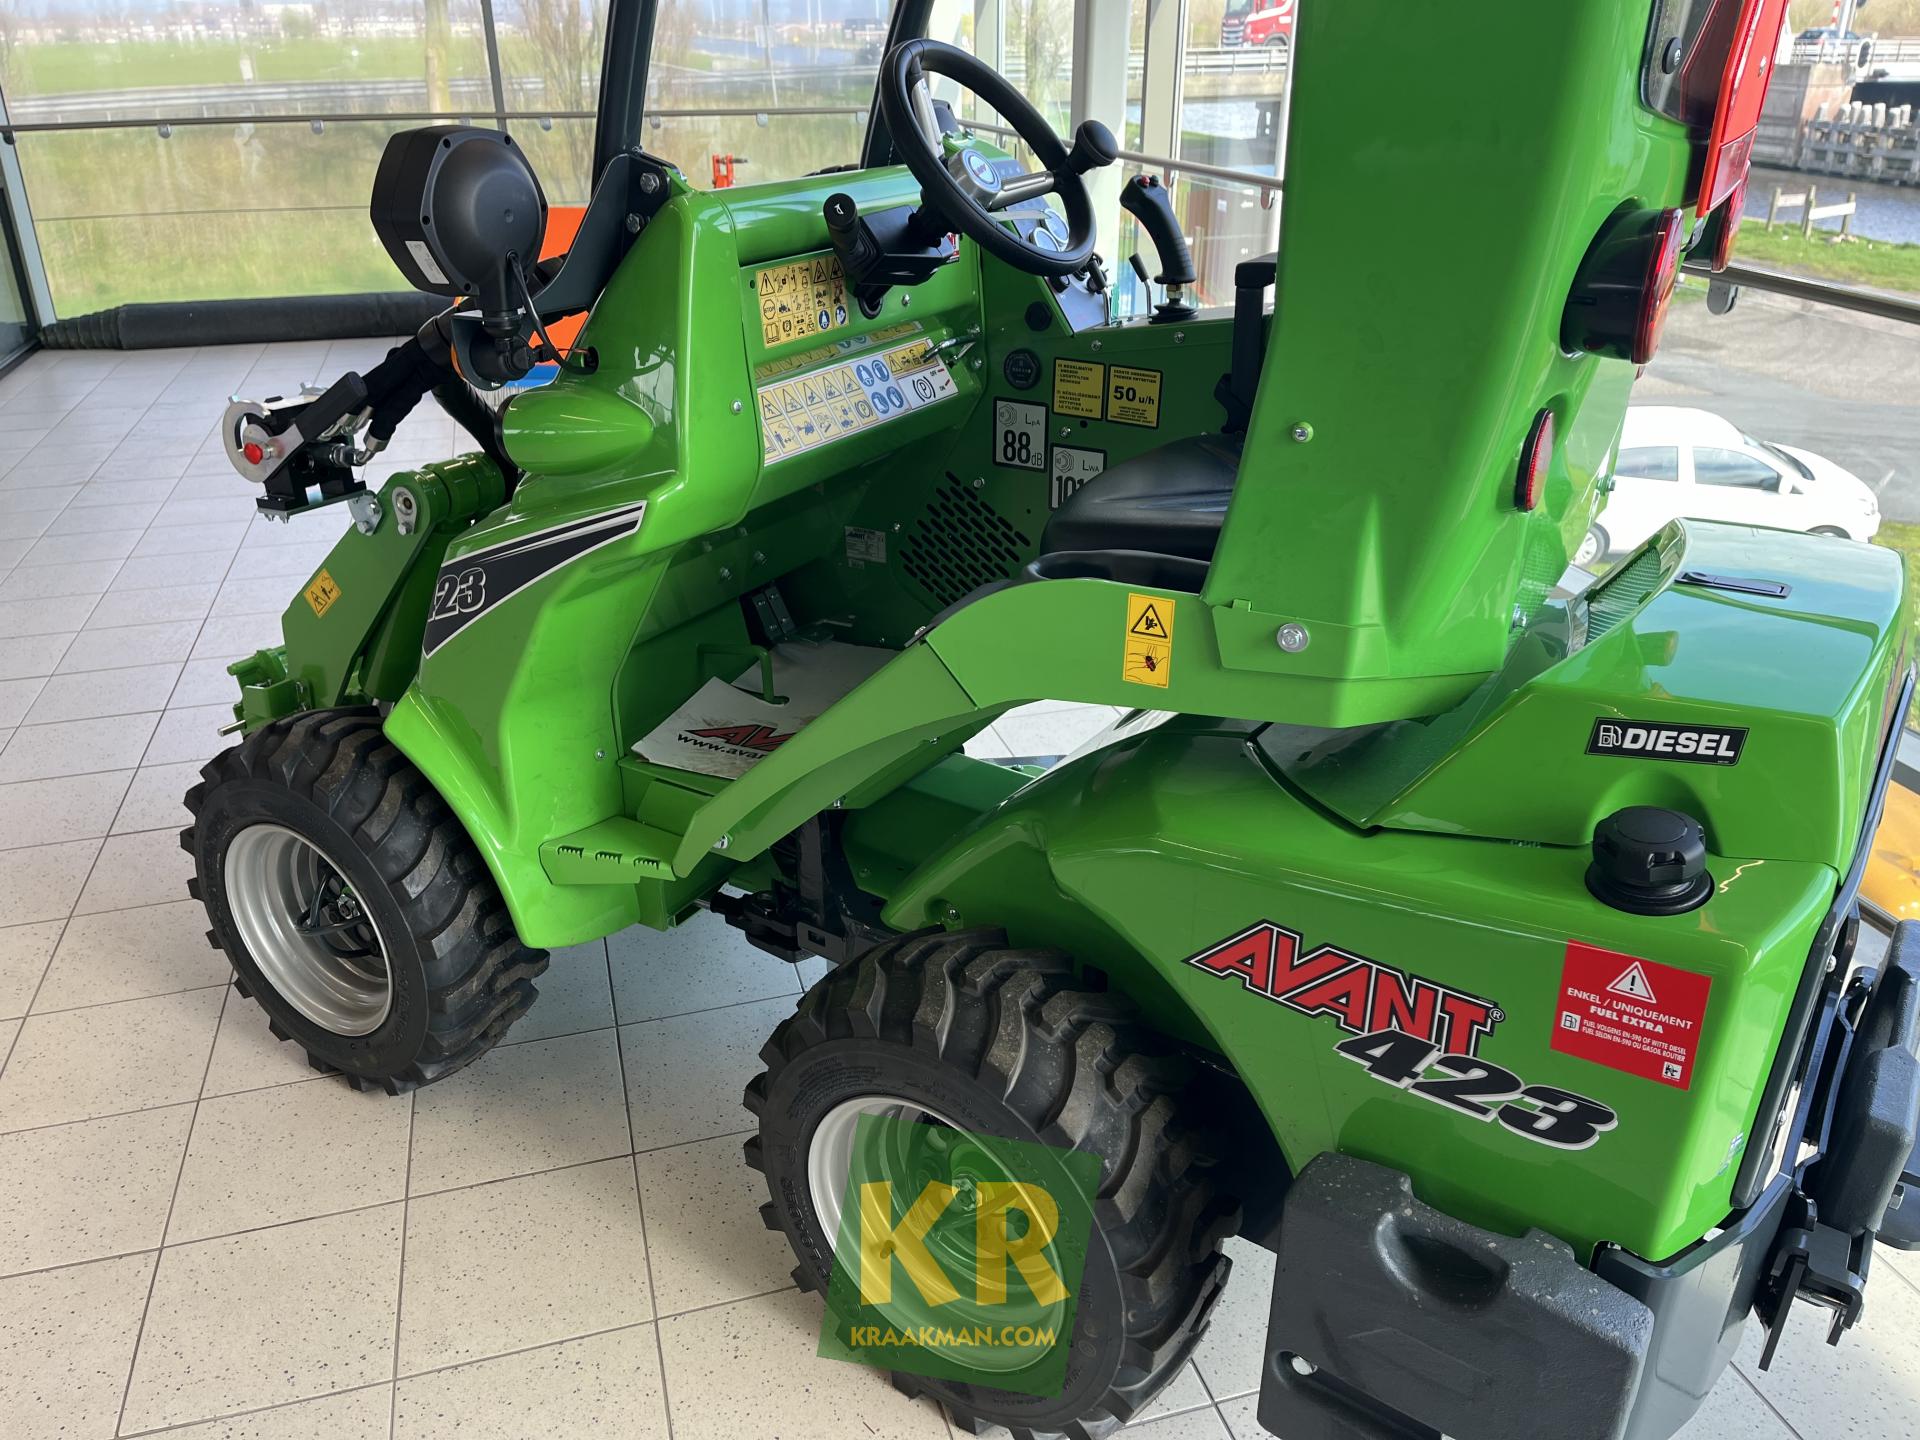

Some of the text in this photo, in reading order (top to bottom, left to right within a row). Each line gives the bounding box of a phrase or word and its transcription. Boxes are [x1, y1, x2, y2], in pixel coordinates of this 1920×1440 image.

[1113, 385, 1155, 405] 50 u/h
[1003, 429, 1043, 467] 88 dB
[428, 567, 486, 622] 23
[1622, 727, 1735, 757] DIESEL
[1183, 919, 1497, 1056] AVANT
[1567, 987, 1693, 1029] ENKEL / UNIQUEMENT
[1590, 1005, 1664, 1034] FUEL EXTRA
[1582, 1026, 1686, 1063] FUEL SELON EN-590 OU GASOIL ROUTIER
[1583, 1019, 1687, 1055] FUEL VOLGENS EN-590 OF WITTE DIESEL
[1334, 1028, 1619, 1150] 423
